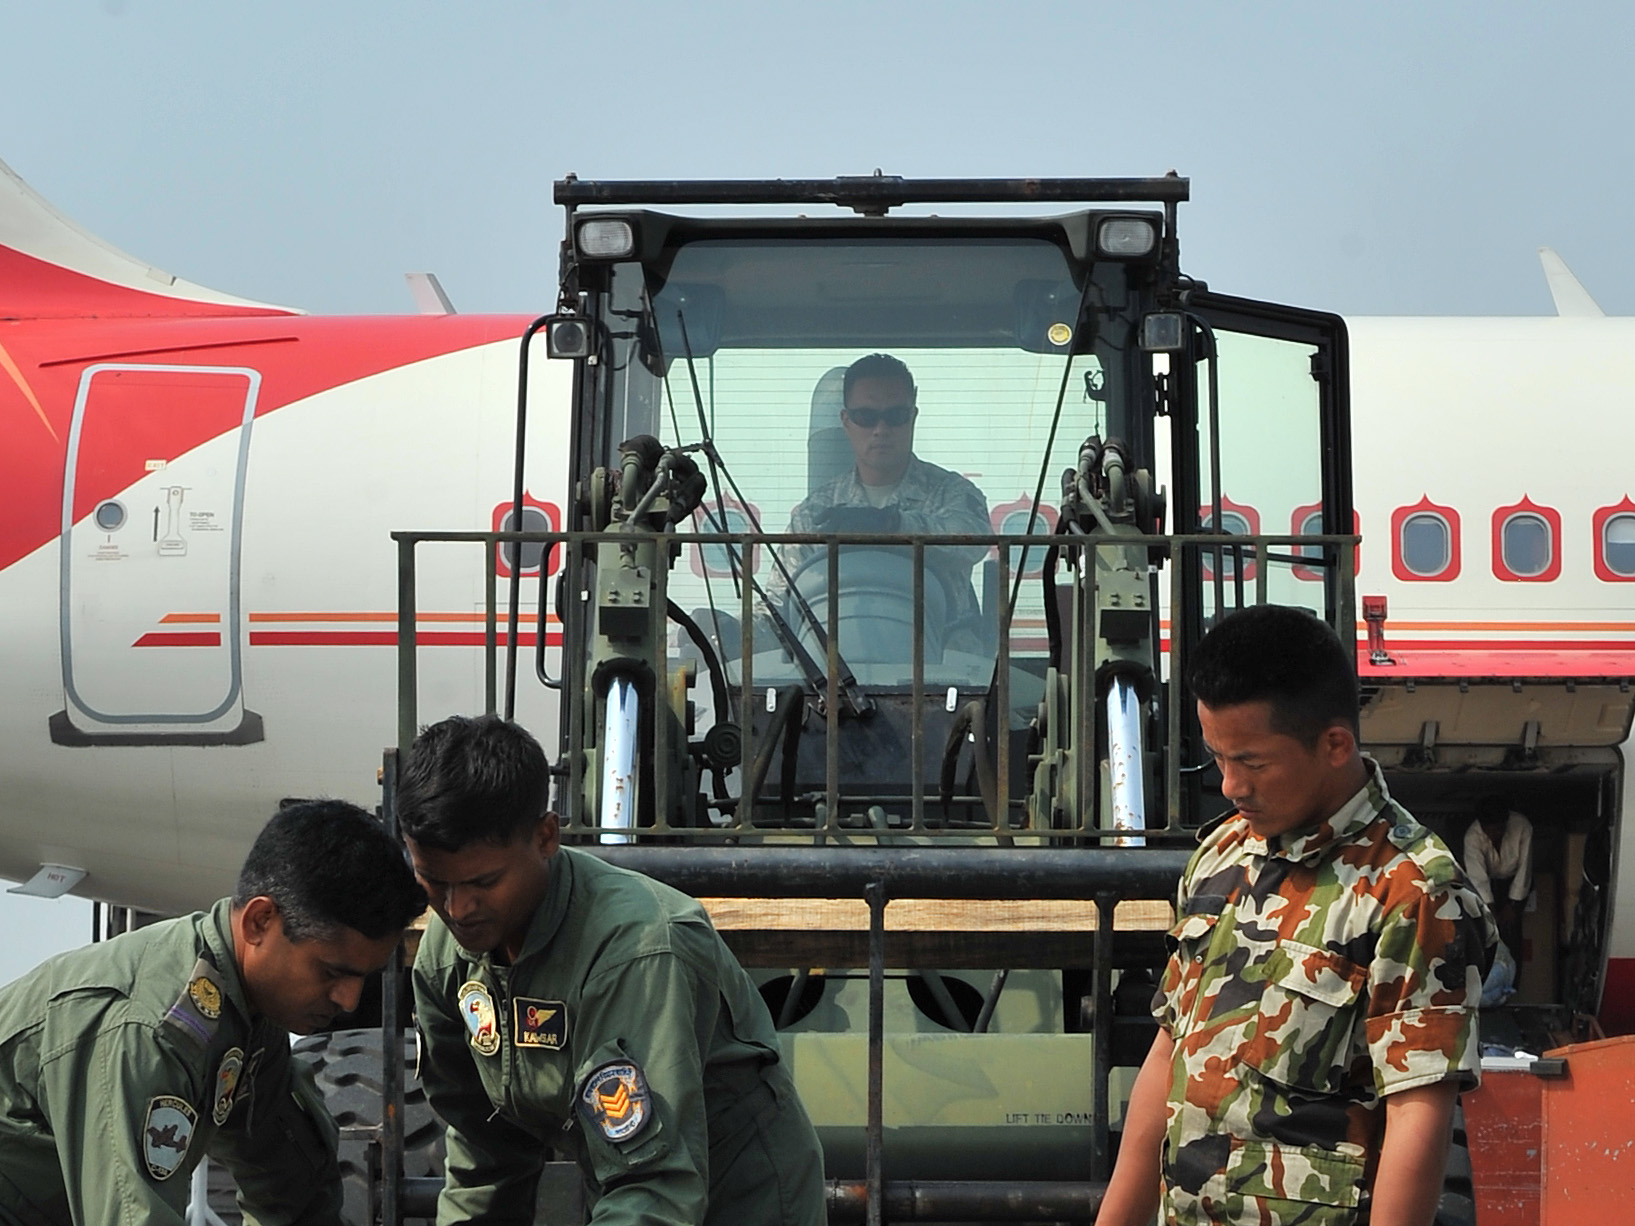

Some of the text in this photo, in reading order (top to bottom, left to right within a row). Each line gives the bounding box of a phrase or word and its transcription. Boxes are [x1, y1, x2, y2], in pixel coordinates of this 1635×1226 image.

[47, 871, 67, 884] HOT
[159, 1099, 192, 1118] HERCULES
[1005, 1111, 1093, 1124] LIFT TIE DOWN
